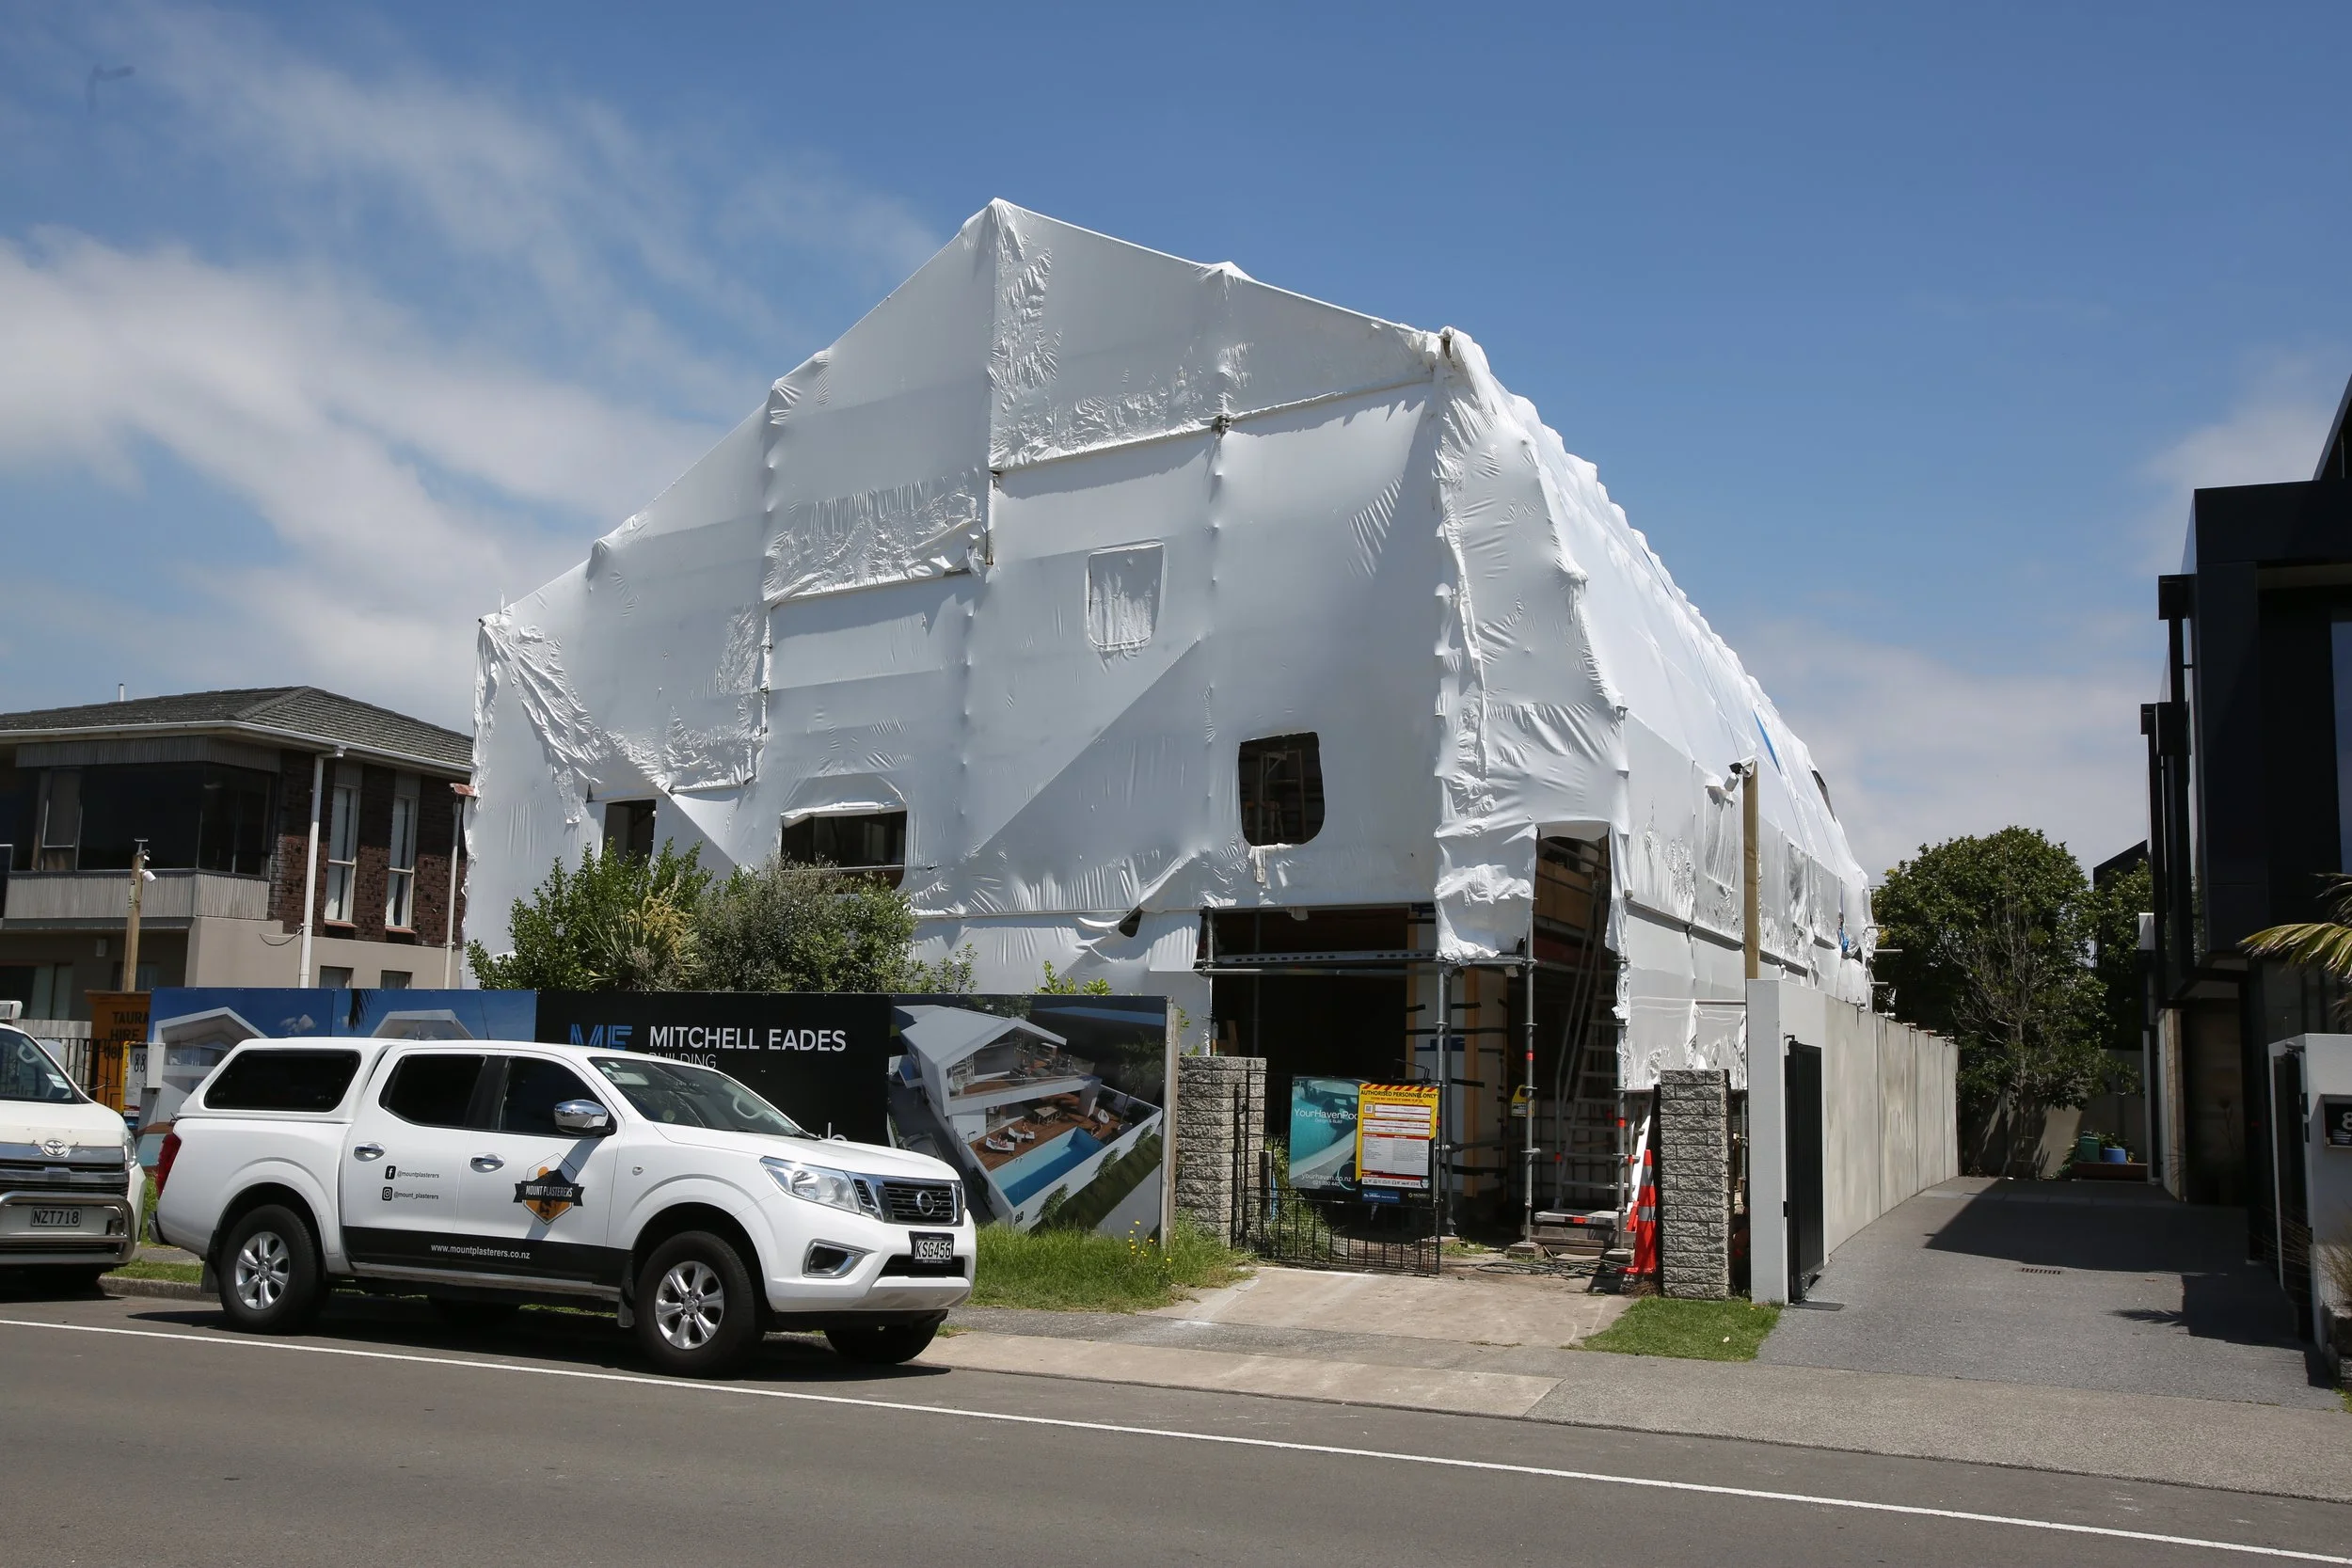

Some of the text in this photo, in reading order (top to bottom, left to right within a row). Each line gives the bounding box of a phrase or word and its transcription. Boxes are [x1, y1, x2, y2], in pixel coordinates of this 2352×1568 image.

[111, 1028, 140, 1040] HIRE
[649, 1026, 847, 1052] MITCHELL EADES
[134, 1053, 148, 1073] 88
[397, 1170, 440, 1179] @mountplasterers
[1301, 1173, 1352, 1182] yourhaven.co.nz
[393, 1191, 439, 1200] @mount_plasterers
[526, 1185, 574, 1197] MOUNT PLASTERERS
[33, 1210, 79, 1225] NZT718
[430, 1243, 532, 1260] www.mountplasterers.co.nz
[915, 1242, 951, 1259] KSG456
